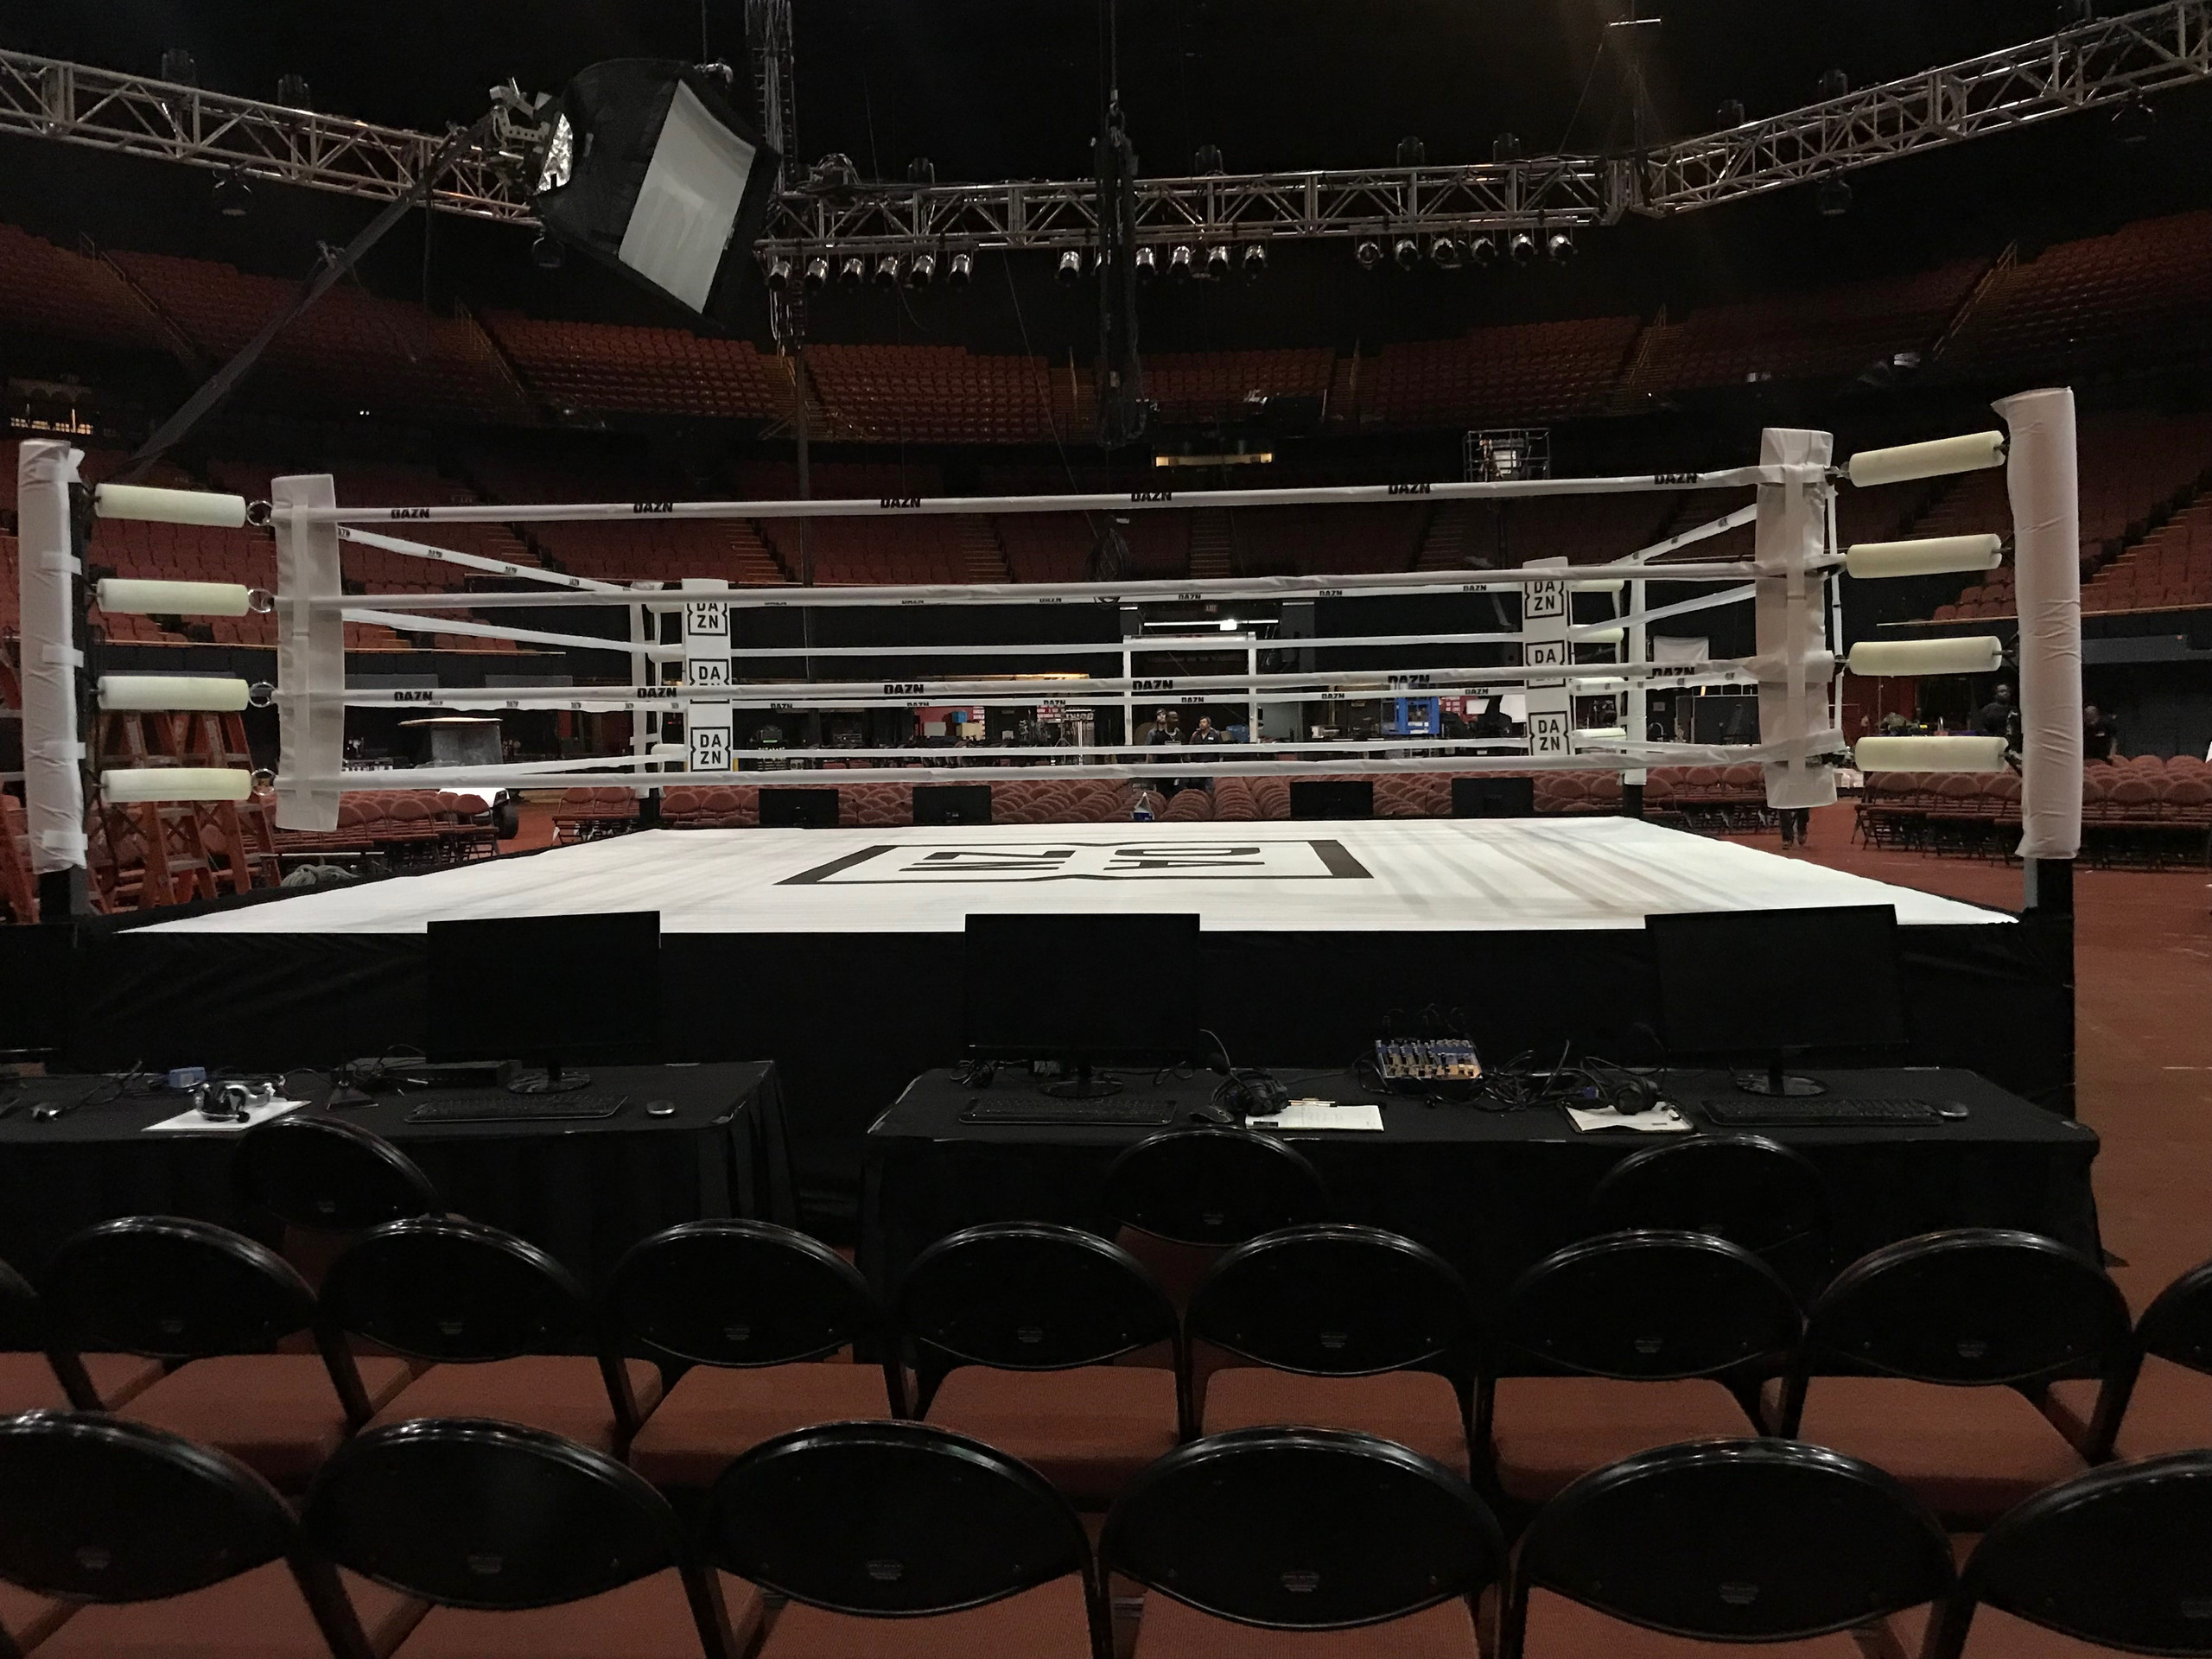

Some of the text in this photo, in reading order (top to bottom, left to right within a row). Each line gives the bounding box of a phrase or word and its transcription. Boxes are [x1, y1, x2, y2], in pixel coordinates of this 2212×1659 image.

[1654, 474, 1698, 485] DAZN
[1389, 485, 1430, 495] DAZN
[1131, 493, 1172, 502] DAZN
[633, 503, 673, 513] DAZN
[880, 499, 921, 508] DAZN
[391, 509, 429, 519] DAZN
[1535, 582, 1555, 592] DA
[1535, 597, 1555, 611] ZN
[697, 614, 719, 628] ZN
[1535, 650, 1556, 664] DA
[699, 666, 721, 680] DA
[1652, 666, 1695, 676] DAZN
[1388, 675, 1430, 683] DAZN
[884, 683, 925, 694] DAZN
[1132, 680, 1173, 690] DAZN
[394, 691, 433, 701] DAZN
[638, 688, 677, 698] DAZN
[1538, 720, 1559, 734] DA
[700, 734, 721, 748] DA
[1540, 737, 1561, 752] ZN
[701, 751, 721, 765] ZN
